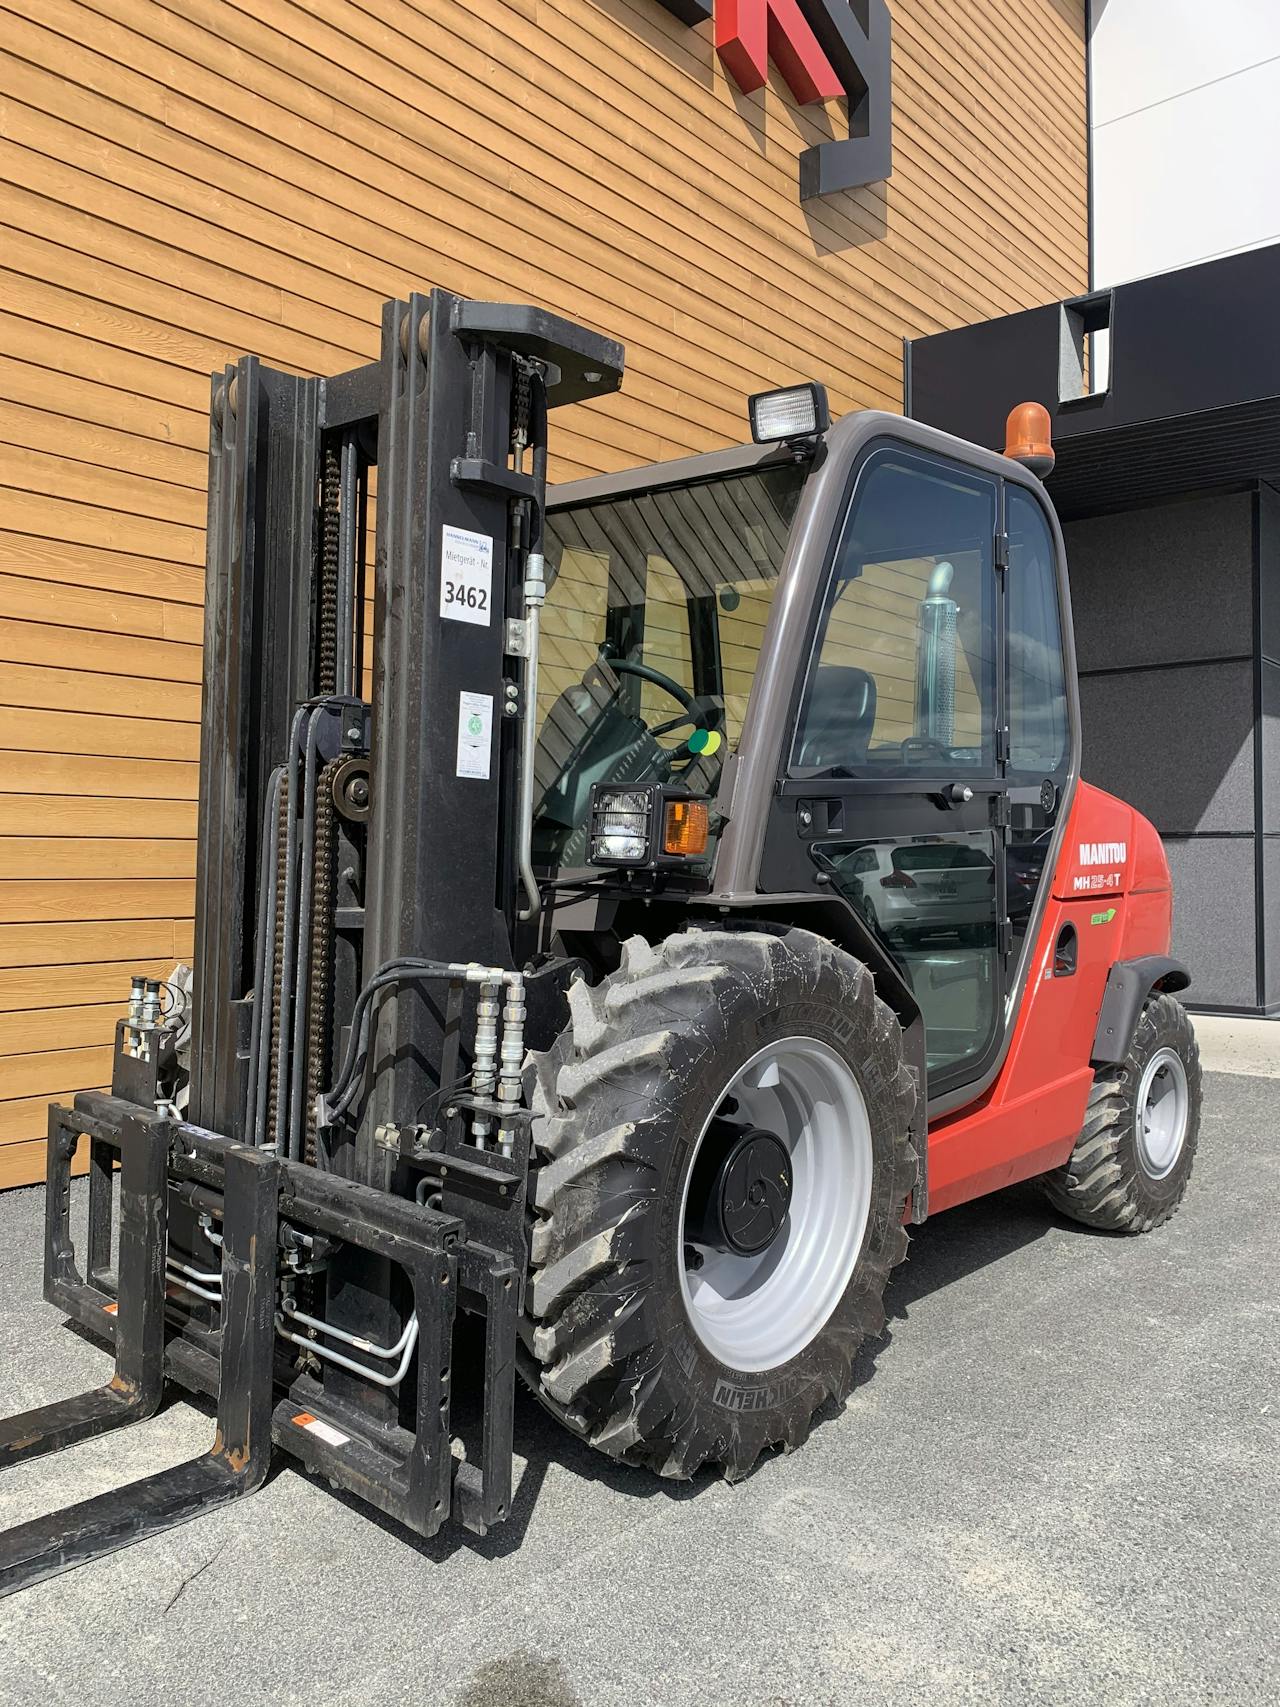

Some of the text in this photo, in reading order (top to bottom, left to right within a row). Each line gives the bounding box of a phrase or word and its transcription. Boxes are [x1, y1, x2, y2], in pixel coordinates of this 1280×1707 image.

[446, 550, 475, 566] Mietgerät
[445, 581, 487, 611] 3462
[1079, 842, 1127, 866] MANITOU
